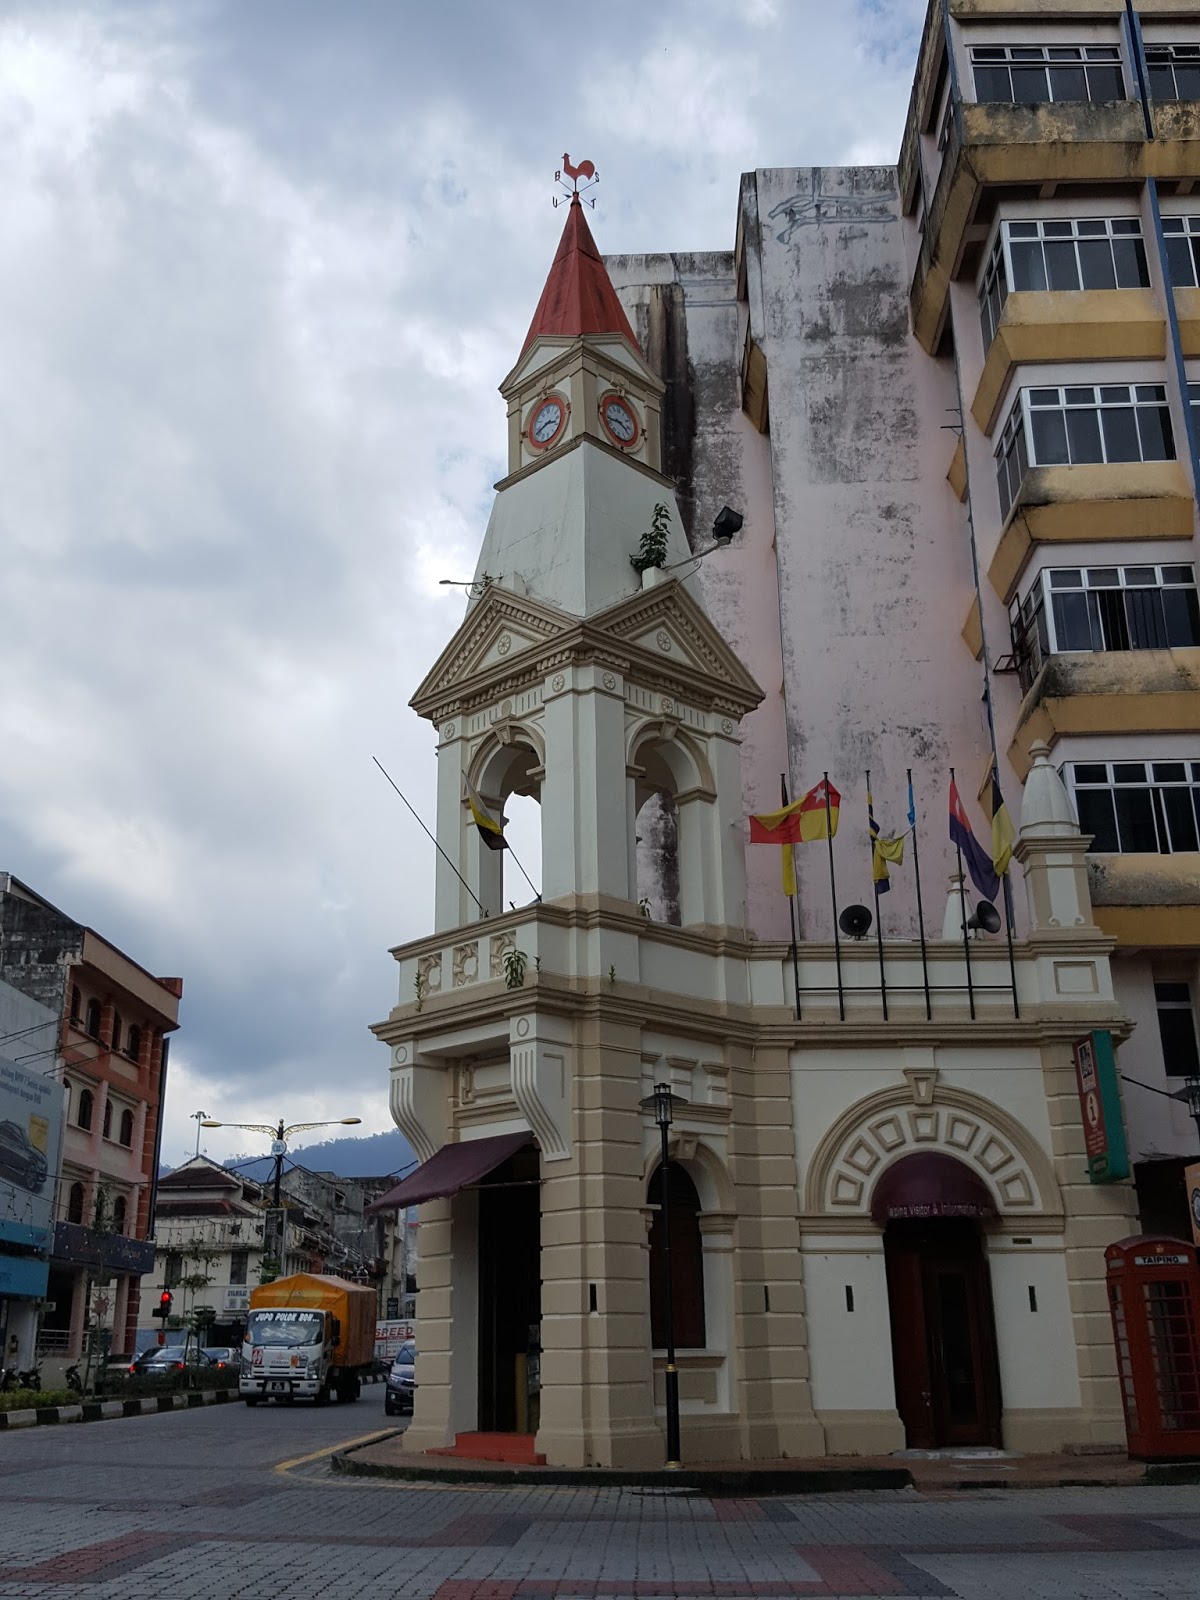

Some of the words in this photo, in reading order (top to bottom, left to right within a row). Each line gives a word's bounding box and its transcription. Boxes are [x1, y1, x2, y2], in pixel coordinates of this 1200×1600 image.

[555, 170, 561, 181] B
[594, 171, 600, 183] S
[552, 196, 558, 208] U
[590, 197, 597, 209] T
[909, 1205, 930, 1215] Visitor
[1142, 1256, 1179, 1264] TAIPING
